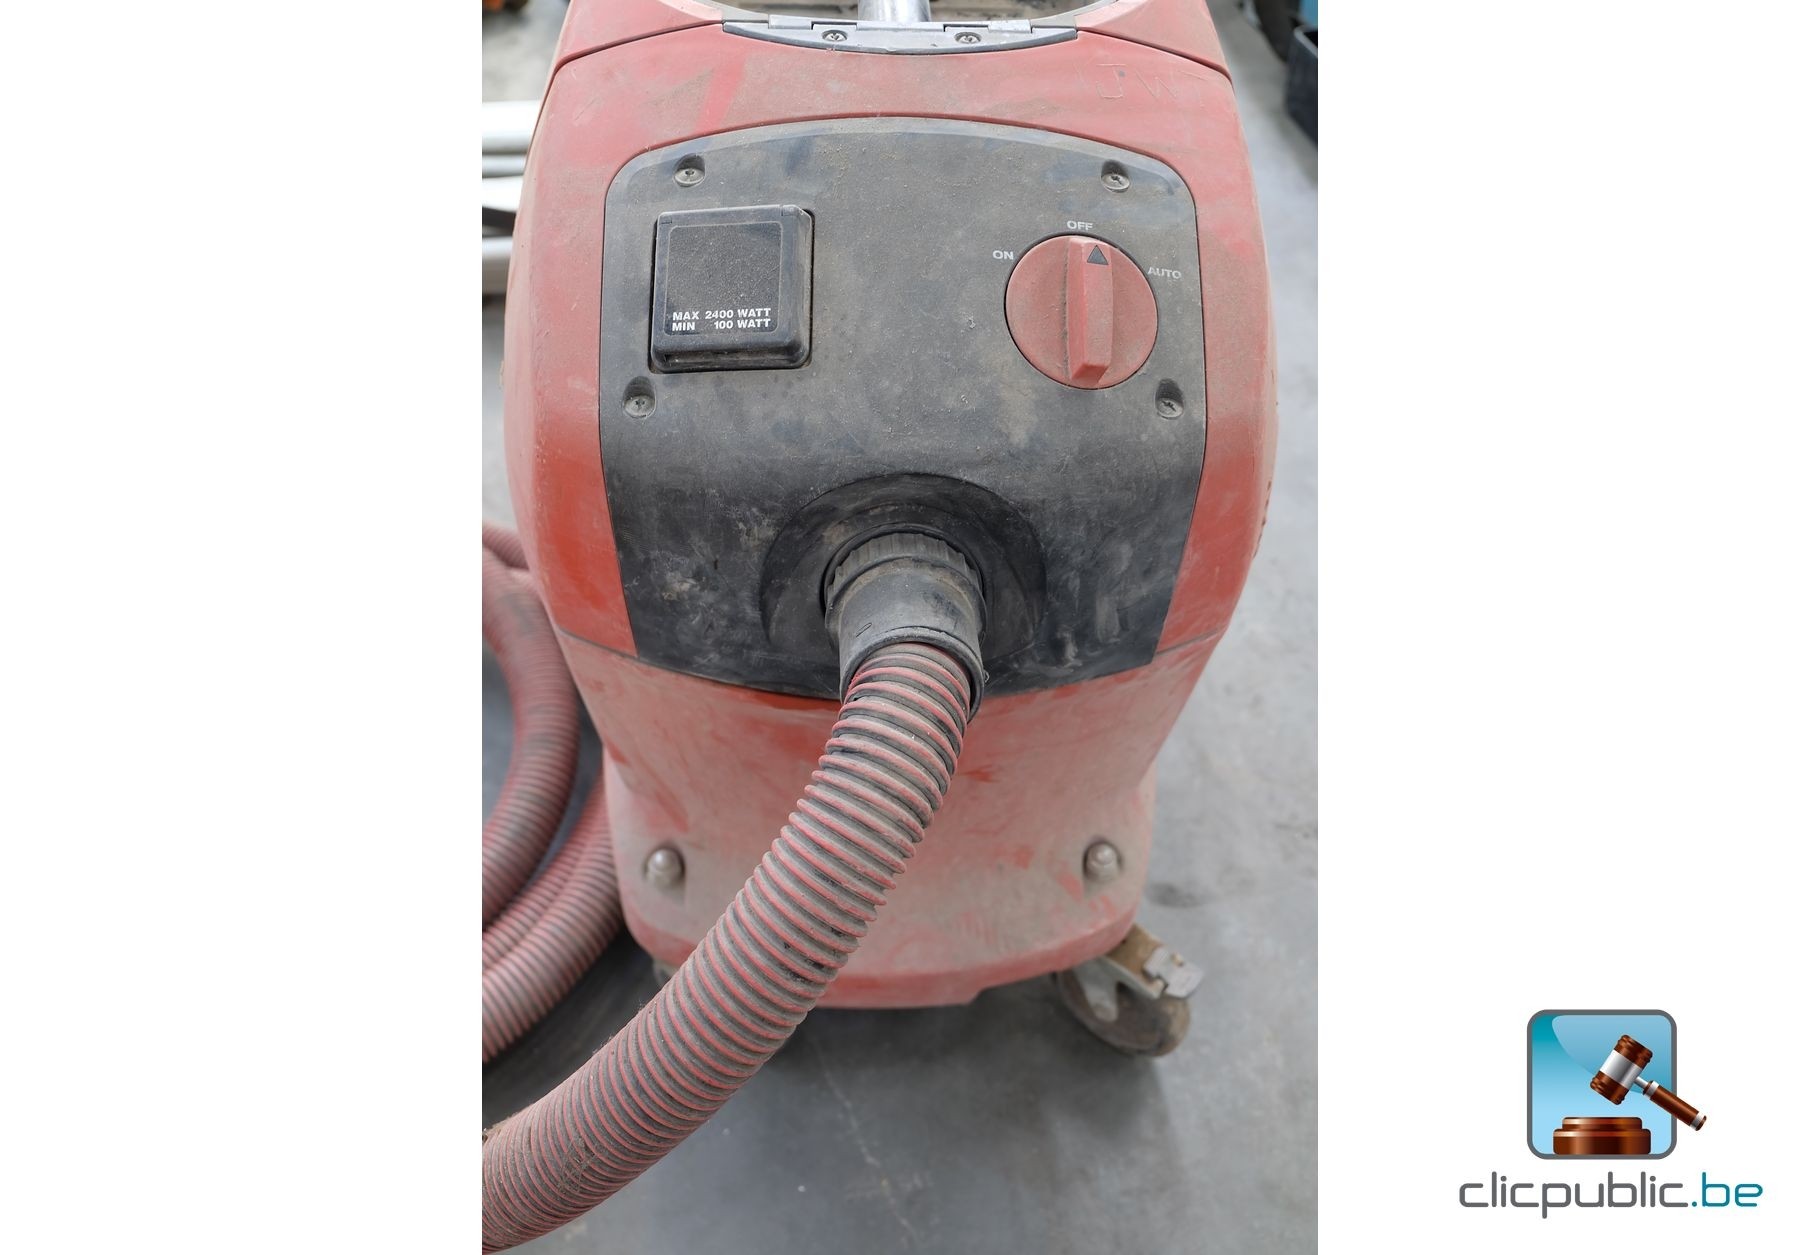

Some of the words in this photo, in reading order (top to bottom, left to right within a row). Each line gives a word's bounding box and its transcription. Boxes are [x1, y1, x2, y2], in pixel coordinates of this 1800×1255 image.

[1066, 220, 1093, 231] OFF
[992, 250, 1014, 260] ON
[1147, 266, 1182, 280] AUTO
[673, 311, 700, 321] MAX
[705, 309, 734, 320] 2400
[737, 308, 772, 318] WATT
[671, 321, 696, 331] MIN
[714, 320, 733, 330] 100
[736, 318, 771, 329] WATT
